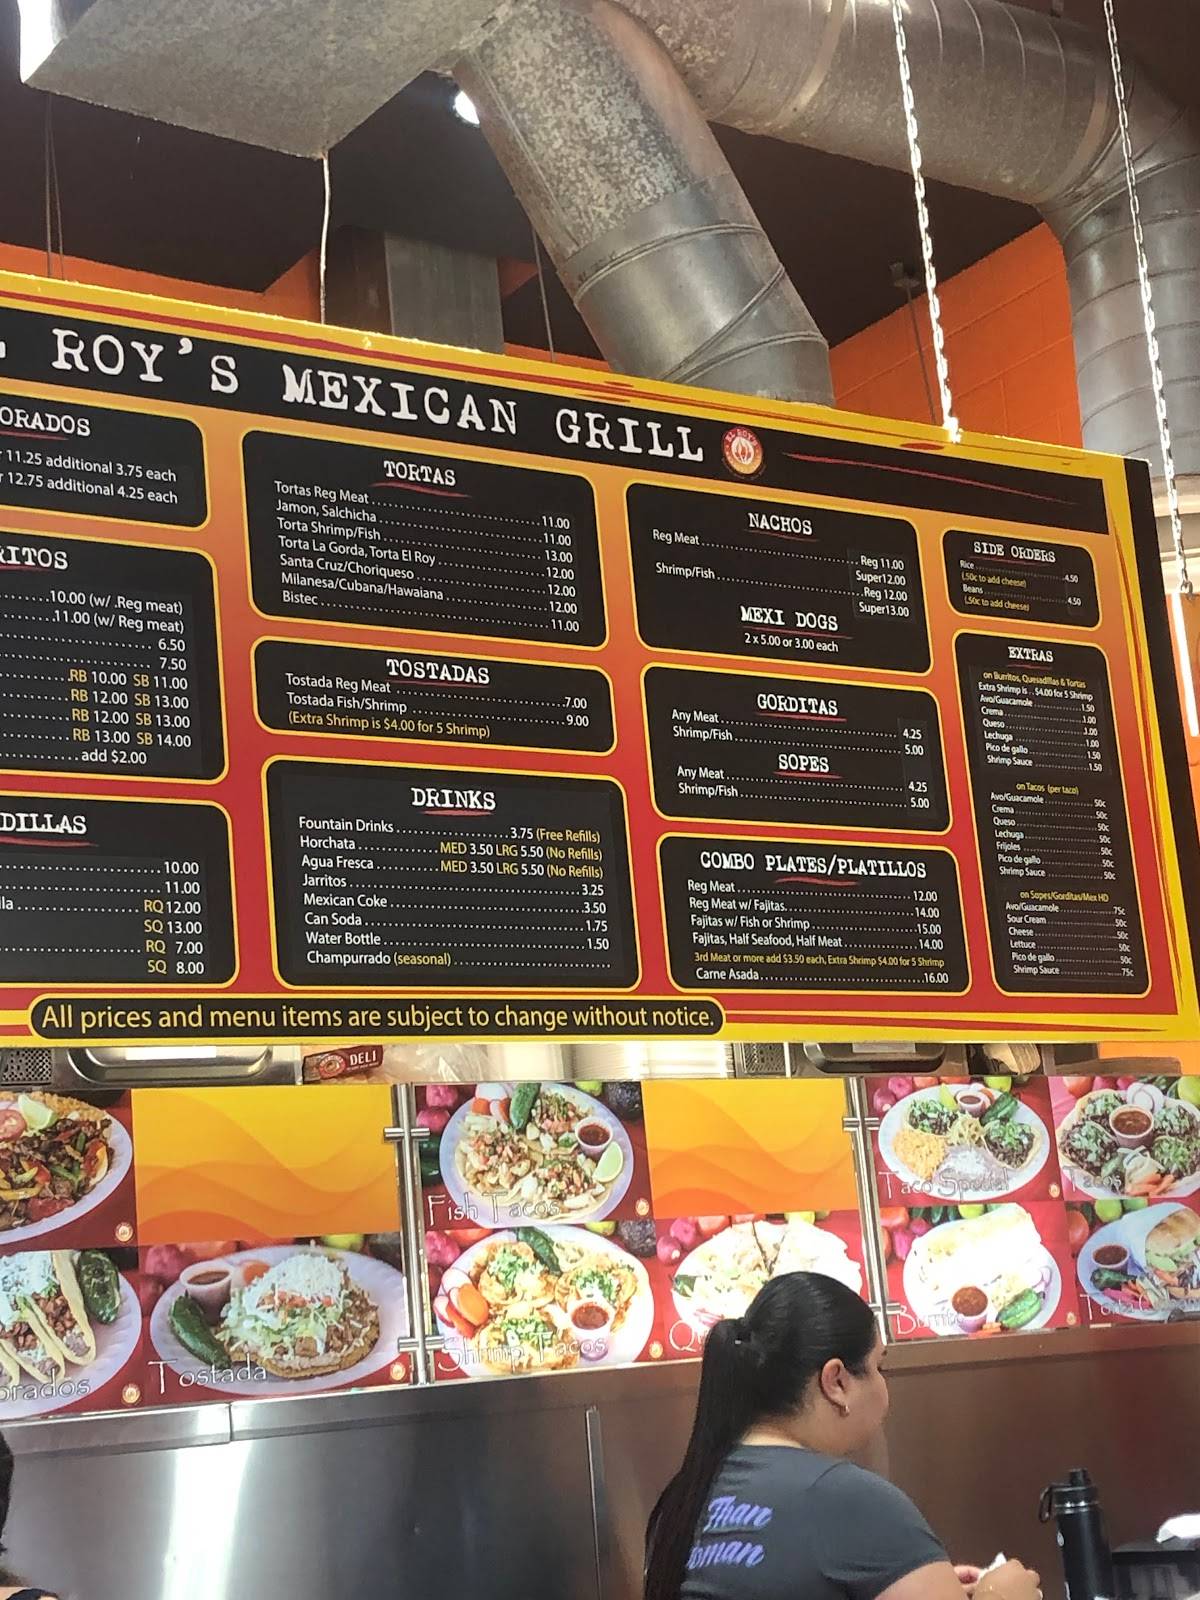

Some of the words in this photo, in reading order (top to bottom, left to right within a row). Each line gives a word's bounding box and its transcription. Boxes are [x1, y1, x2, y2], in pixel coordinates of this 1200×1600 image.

[52, 329, 238, 393] ROY'S
[282, 364, 517, 435] MEXICAN
[556, 409, 703, 461] GRILL
[7, 450, 42, 465] 11.25
[46, 455, 112, 473] additional
[117, 463, 142, 477] 3.75
[146, 469, 176, 481] each
[384, 461, 455, 487] TORTAS
[8, 472, 43, 487] 12.75
[47, 478, 113, 495] additional
[118, 486, 144, 499] 4.25
[148, 491, 177, 503] each
[274, 481, 311, 496] Tortas
[314, 486, 336, 502] Reg
[340, 489, 368, 504] Meat
[543, 516, 569, 529] 11.00
[277, 499, 319, 516] Jamon,
[322, 505, 376, 522] Salchicha
[544, 533, 571, 546] 11.00
[749, 513, 812, 535] NACHOS
[278, 535, 309, 549] Torta
[313, 540, 326, 551] La
[329, 542, 367, 558] Gorda,
[369, 546, 399, 560] Torta
[402, 550, 411, 561] El
[415, 551, 435, 566] Roy
[547, 567, 574, 580] 12.00
[653, 529, 672, 544] Reg
[675, 532, 699, 545] Meat
[861, 556, 878, 569] Reg
[881, 558, 904, 570] 11.00
[974, 542, 1004, 556] SIDE
[1011, 546, 1055, 562] ORDERS
[280, 554, 313, 568] Santa
[317, 558, 414, 579] Cruz/Choriqueso
[548, 584, 575, 597] 12.00
[656, 562, 715, 579] Shrimp/Fish
[55, 610, 90, 624] 11.00
[94, 613, 115, 627] (w/
[119, 615, 143, 632] Reg
[147, 621, 183, 634] meat)
[283, 590, 317, 605] Bistec
[552, 619, 579, 632] 11.00
[741, 606, 785, 625] MEXI
[795, 612, 838, 631] DOGS
[159, 638, 185, 651] 6.50
[745, 633, 750, 643] 2
[761, 635, 780, 646] 5.00
[783, 639, 792, 647] or
[795, 638, 814, 649] 3.00
[816, 641, 838, 651] each
[1008, 647, 1053, 662] EXTRAS
[68, 669, 87, 682] RB
[92, 671, 126, 685] 10.00
[133, 674, 149, 687] SB
[154, 676, 187, 689] 11.00
[387, 659, 489, 684] TOSTADAS
[286, 673, 332, 688] Tostada
[336, 677, 358, 693] Reg
[362, 680, 390, 693] Meat
[565, 697, 587, 709] 7.00
[758, 694, 837, 715] GORDITAS
[289, 711, 323, 724] (Extra
[326, 714, 369, 730] Shrimp
[372, 717, 381, 729] is
[384, 718, 415, 731] $4.00
[418, 720, 433, 732] for
[437, 723, 443, 733] 5
[446, 723, 489, 739] Shrimp)
[672, 709, 691, 723] Any
[694, 711, 719, 723] Meat
[903, 729, 921, 739] 4.25
[82, 749, 107, 762] add
[112, 750, 146, 764] $2.00
[986, 743, 1000, 751] Pico
[1001, 744, 1010, 752] de
[1011, 745, 1028, 755] gallo
[779, 754, 829, 772] SOPES
[411, 788, 495, 810] DRINKS
[679, 783, 738, 797] Shrimp/Fish
[911, 797, 929, 808] 5.00
[299, 817, 353, 830] Fountain
[356, 819, 393, 832] Drinks
[511, 827, 533, 839] 3.75
[537, 828, 563, 841] (Free
[566, 830, 600, 843] Refills)
[995, 830, 1024, 840] Lechuga
[301, 836, 355, 849] Horchata
[441, 842, 467, 854] MED
[470, 843, 493, 855] 3.50
[496, 845, 518, 856] LRG
[521, 846, 543, 857] 5.50
[546, 847, 565, 859] (No
[568, 848, 602, 861] Refills)
[165, 862, 198, 874] 10.00
[701, 852, 754, 869] COMBO
[765, 855, 926, 878] PLATES/PLATILLOS
[166, 881, 200, 894] 11.00
[688, 880, 707, 894] Reg
[710, 881, 735, 892] Meat
[914, 891, 937, 901] 12.00
[144, 900, 163, 913] RQ
[167, 901, 201, 914] 12.00
[691, 915, 723, 928] Fajitas
[725, 916, 737, 927] w/
[741, 917, 760, 929] Fish
[762, 919, 772, 927] or
[775, 917, 810, 931] Shrimp
[917, 924, 941, 934] 15.00
[306, 932, 342, 944] Water
[345, 932, 380, 945] Bottle
[588, 938, 609, 949] 1.50
[1010, 940, 1036, 949] Lettuce
[148, 960, 166, 974] SQ
[177, 962, 204, 974] 8.00
[307, 951, 391, 966] Champurrado
[394, 952, 451, 966] (seasonal)
[696, 968, 726, 979] Carne
[729, 968, 759, 980] Asada
[925, 973, 948, 983] 16.00
[42, 1005, 72, 1027] All
[81, 1006, 151, 1033] prices
[159, 1005, 202, 1027] and
[211, 1010, 275, 1026] menu
[283, 1006, 342, 1026] items
[349, 1011, 381, 1026] are
[388, 1005, 463, 1031] subject
[468, 1008, 489, 1026] to
[495, 1005, 567, 1031] change
[573, 1005, 647, 1025] without
[653, 1007, 713, 1026] notice.
[350, 1050, 378, 1066] DELI
[427, 1193, 479, 1227] Fish
[484, 1191, 560, 1224] Tacos
[147, 1352, 267, 1395] Tostada
[687, 1540, 765, 1570] oman
